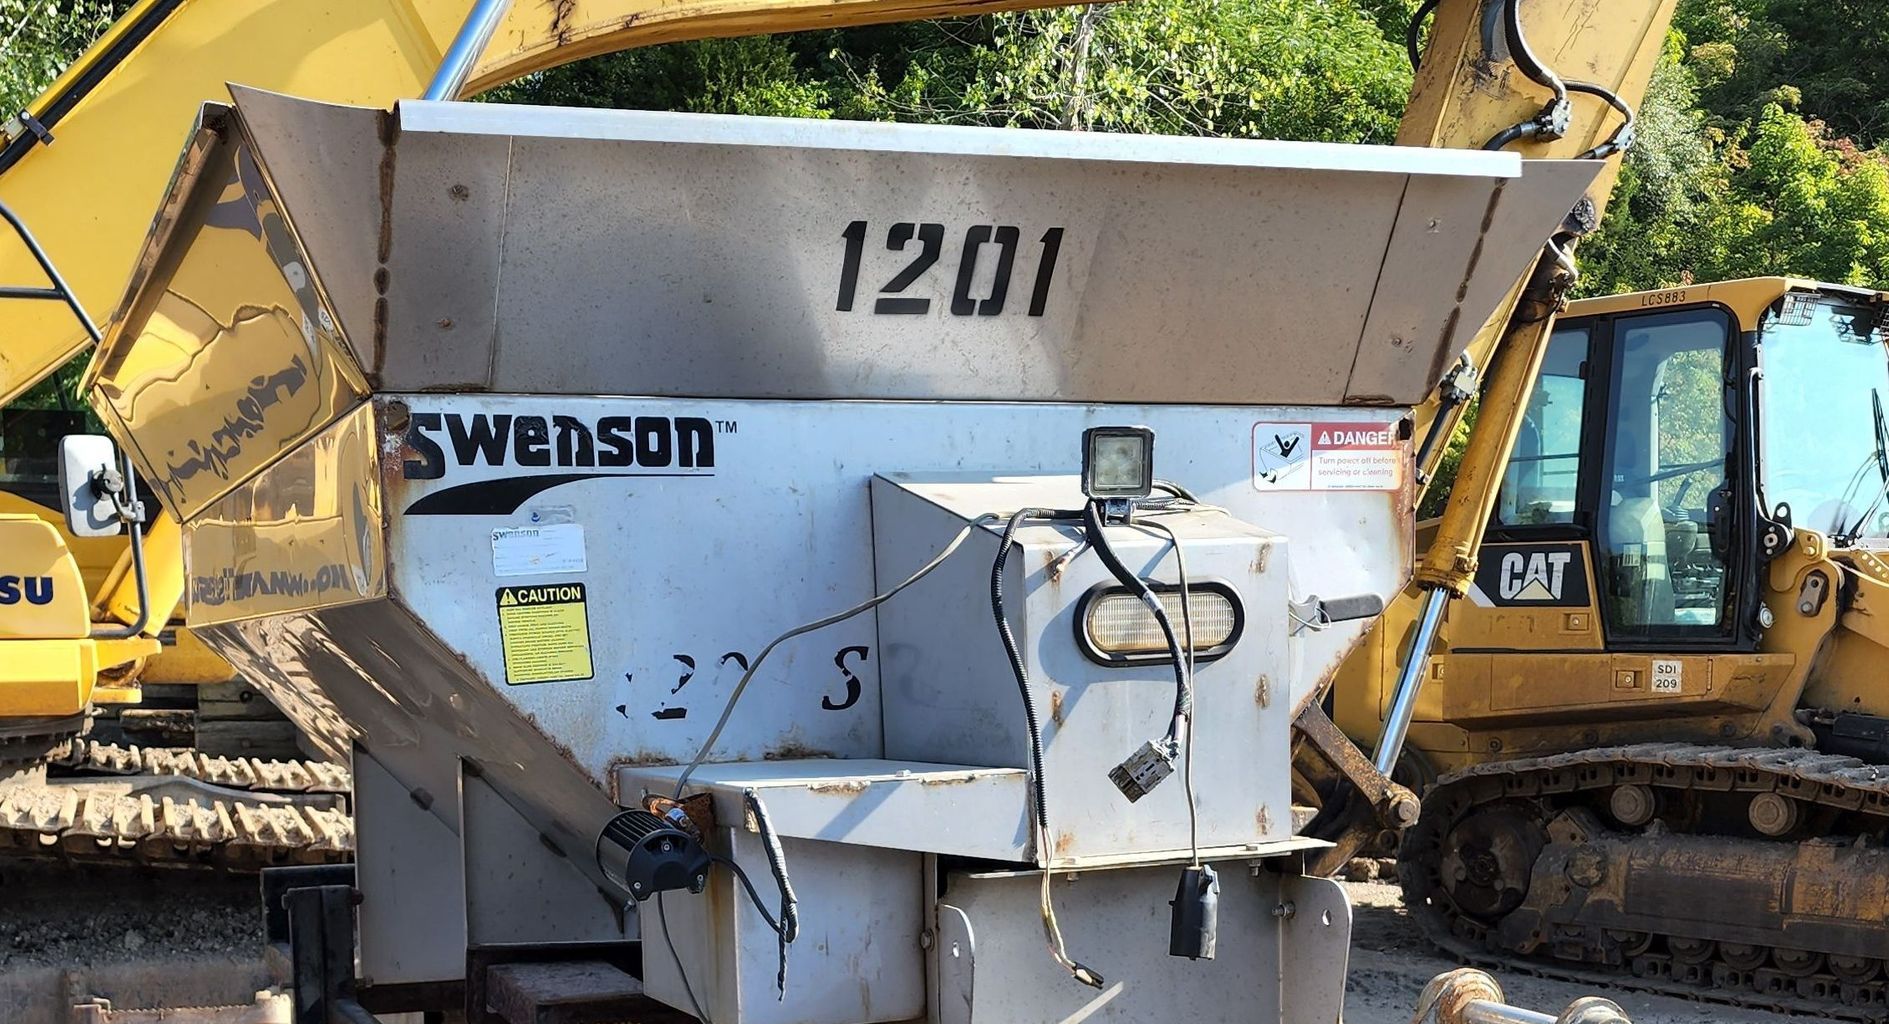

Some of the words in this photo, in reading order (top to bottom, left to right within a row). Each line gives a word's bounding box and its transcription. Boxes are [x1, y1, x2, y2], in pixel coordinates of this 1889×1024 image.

[836, 221, 1064, 316] 1201
[1641, 290, 1686, 307] LCS883
[1318, 457, 1335, 465] Turn
[1360, 456, 1371, 465] off
[1372, 457, 1396, 465] before
[1318, 468, 1352, 478] servicing
[1500, 552, 1571, 600] CAT
[518, 587, 581, 603] CAUTION
[1657, 664, 1677, 674] SDI
[1655, 678, 1677, 689] 209
